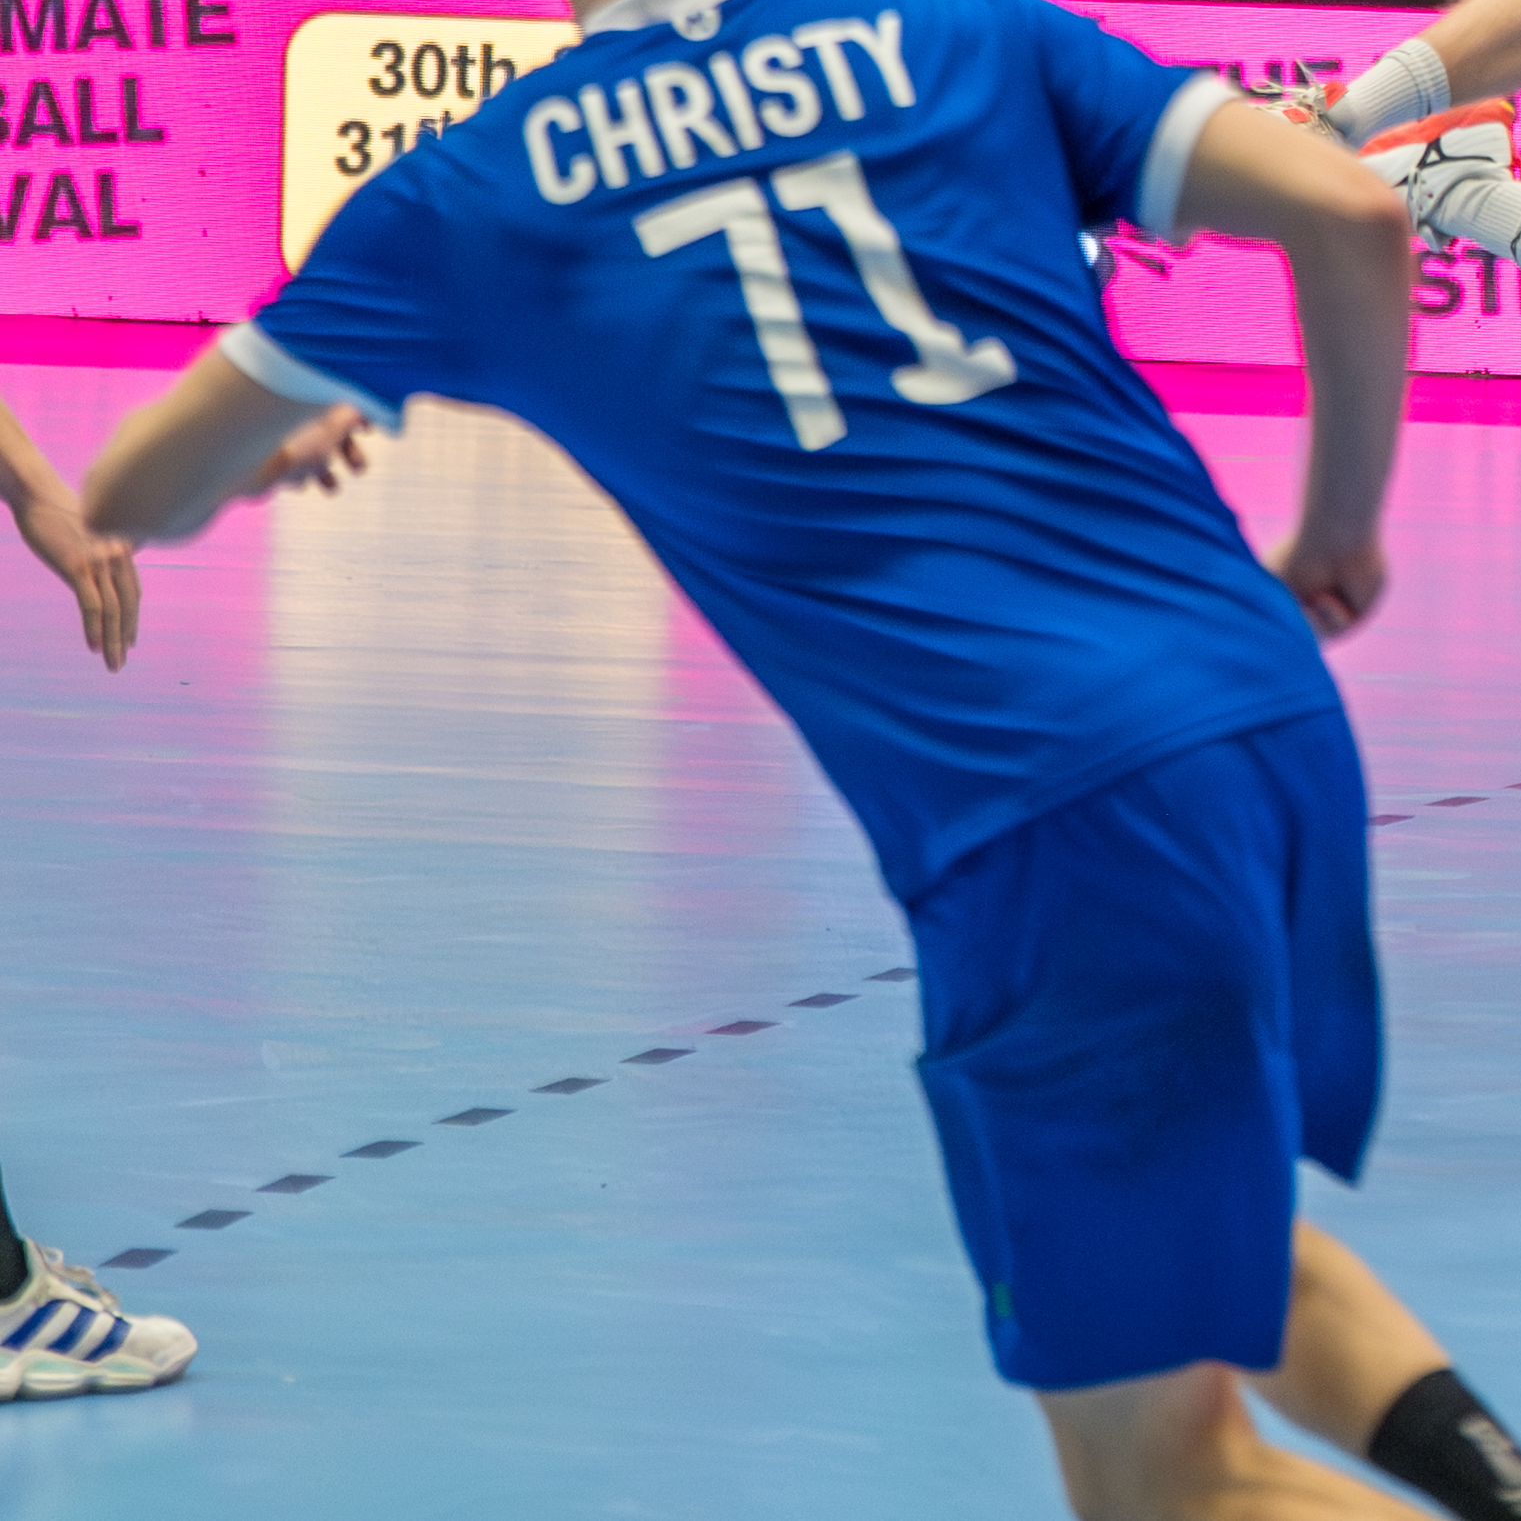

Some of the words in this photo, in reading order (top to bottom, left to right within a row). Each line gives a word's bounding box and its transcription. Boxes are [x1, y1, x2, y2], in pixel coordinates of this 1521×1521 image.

[0, 76, 166, 147] ALL
[522, 9, 918, 206] CHRISTY
[632, 148, 1017, 452] 71
